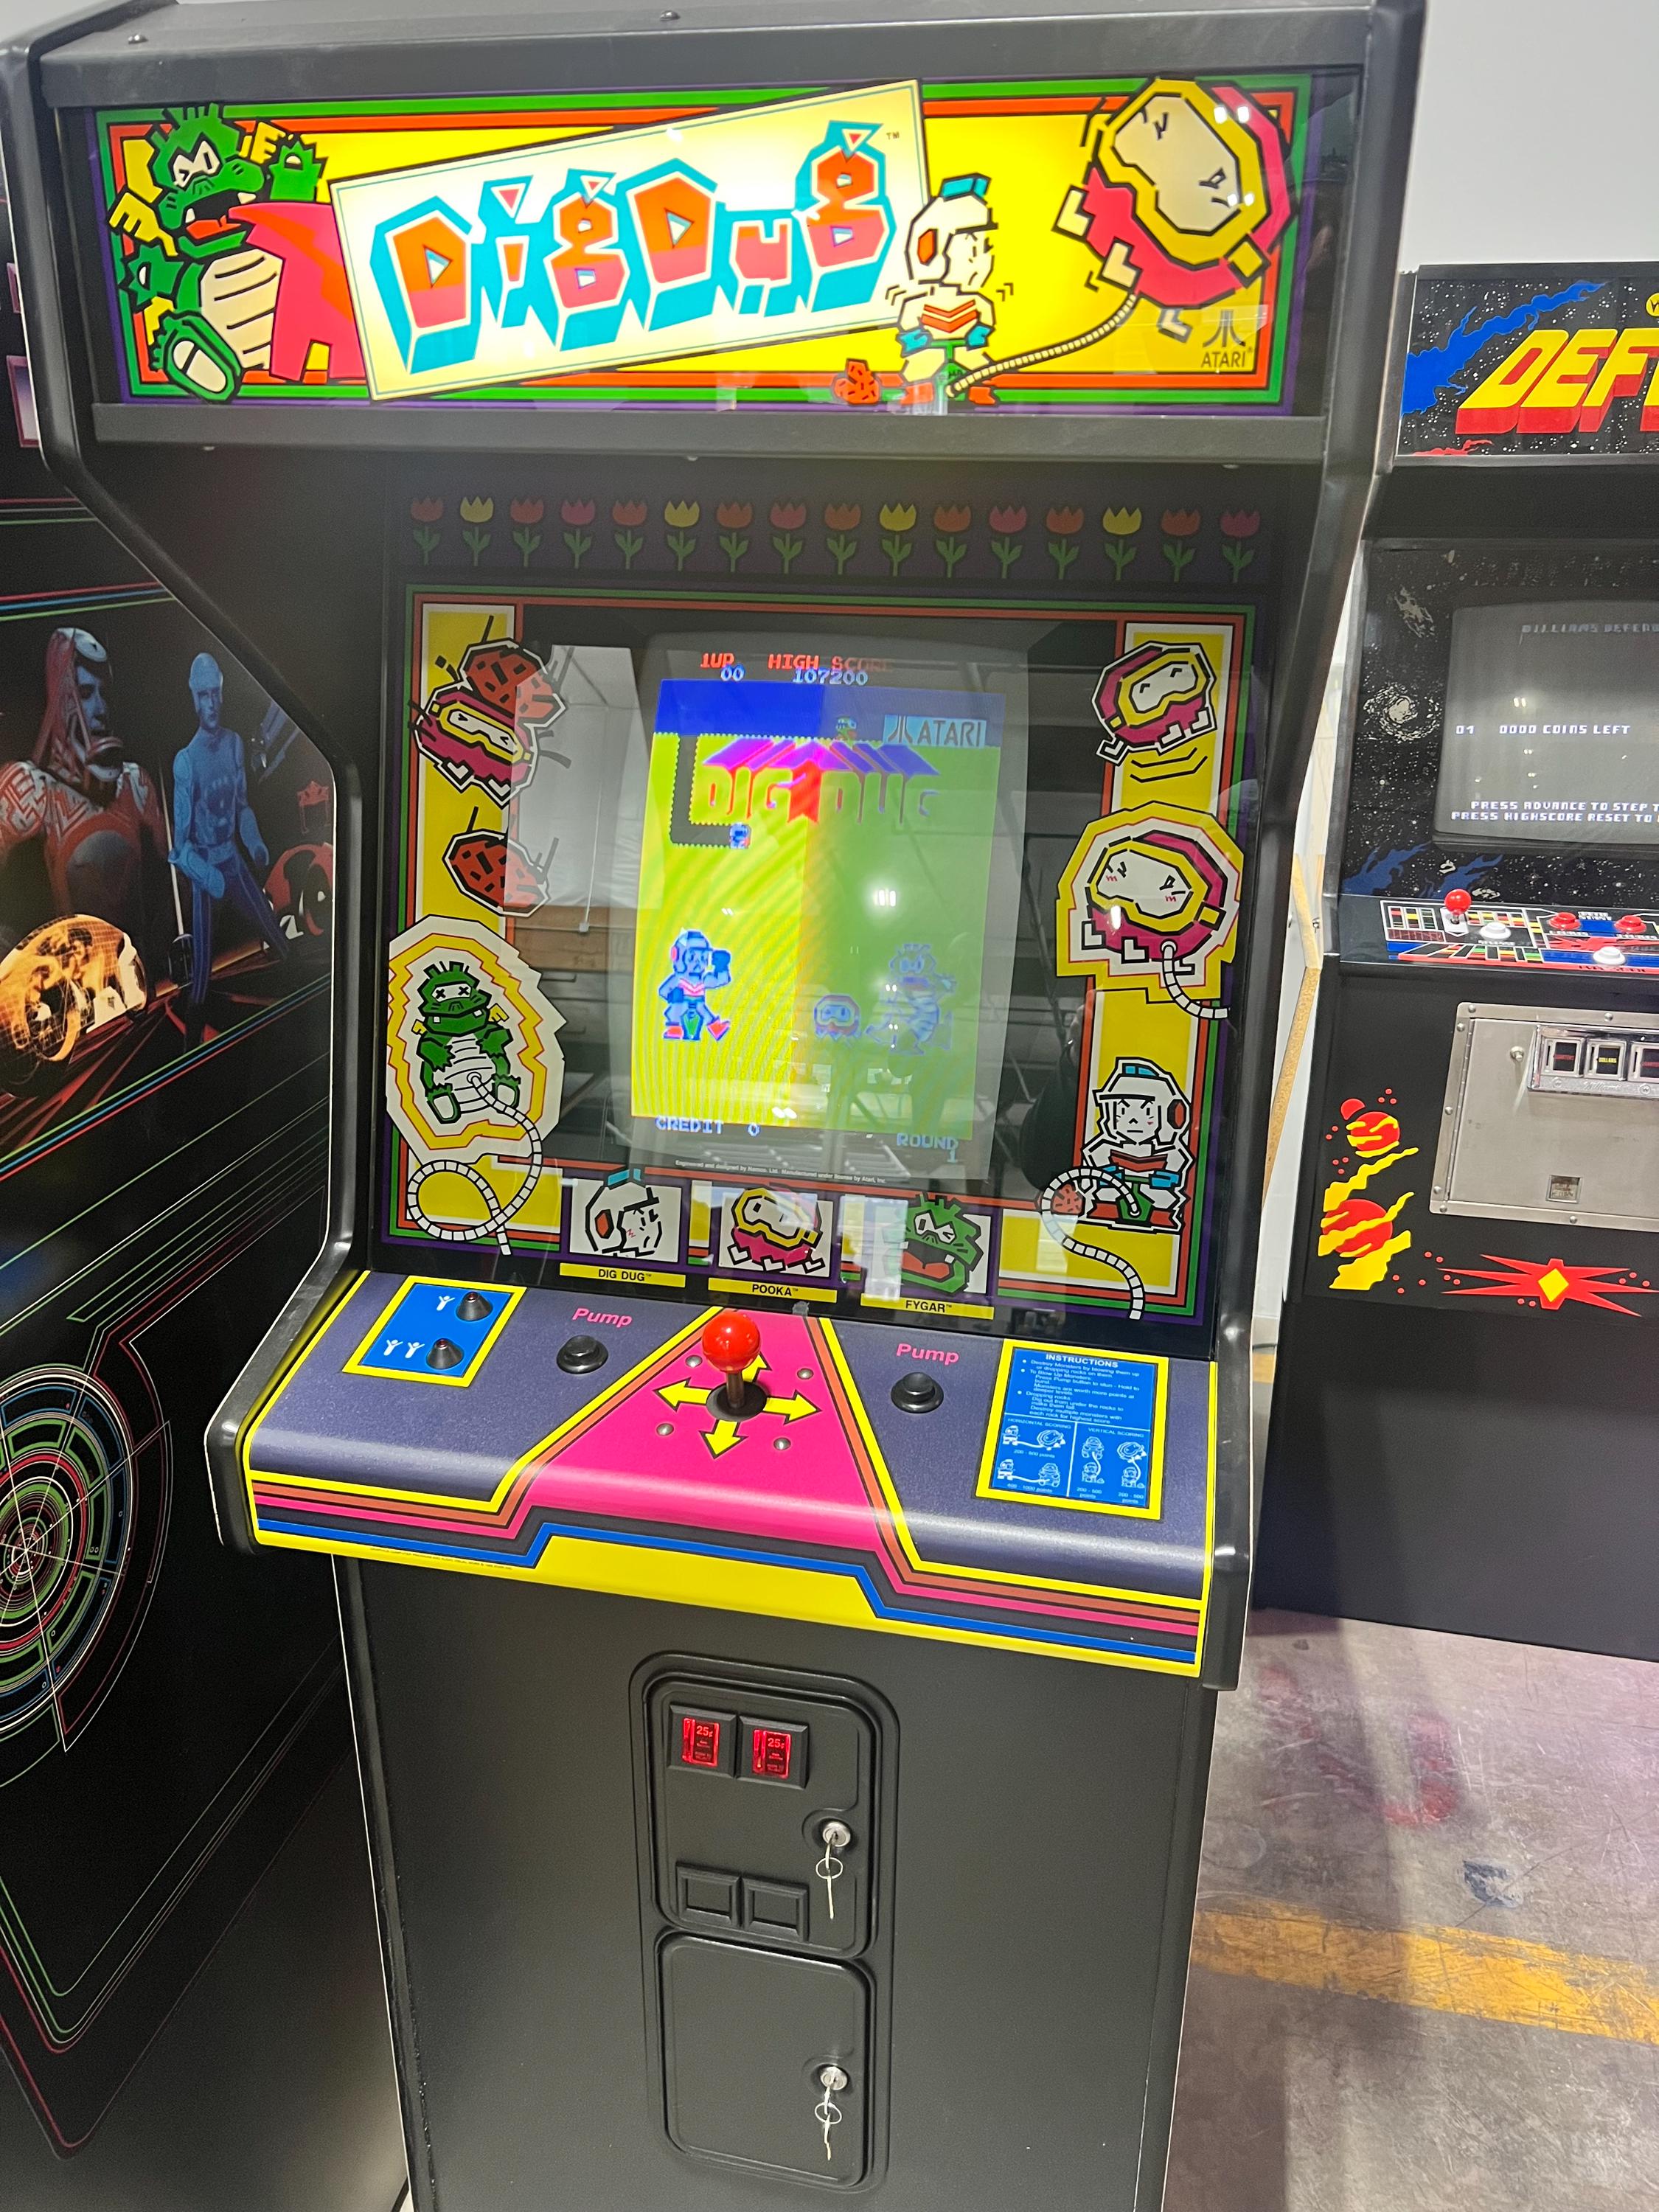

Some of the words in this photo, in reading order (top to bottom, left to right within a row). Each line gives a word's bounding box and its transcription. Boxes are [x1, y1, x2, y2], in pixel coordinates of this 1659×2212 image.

[1455, 327, 1659, 434] DEF
[700, 652, 735, 669] 1UP
[768, 653, 819, 670] HIGH
[832, 655, 891, 672] SCORE
[720, 667, 745, 682] 00
[793, 669, 869, 686] 107200
[920, 720, 984, 748] ATARI
[1455, 725, 1475, 734] 01
[1499, 725, 1537, 734] 0000
[1543, 725, 1587, 734] COINS
[1593, 725, 1631, 734] LEFT
[1471, 801, 1518, 810] PRESS
[1523, 801, 1586, 811] ADVANCE
[1590, 802, 1608, 811] TO
[1613, 803, 1648, 812] STEP
[1451, 812, 1498, 821] PRESS
[1503, 813, 1583, 822] HIGHSCORE
[1587, 813, 1630, 822] RESET
[1634, 814, 1652, 823] TO
[655, 1116, 723, 1135] CREDIT
[897, 1133, 959, 1150] ROUND
[598, 1269, 617, 1279] DIG
[571, 1307, 633, 1328] Pump
[896, 1343, 960, 1366] Pump
[1046, 1354, 1119, 1368] INSTRUCTIONS
